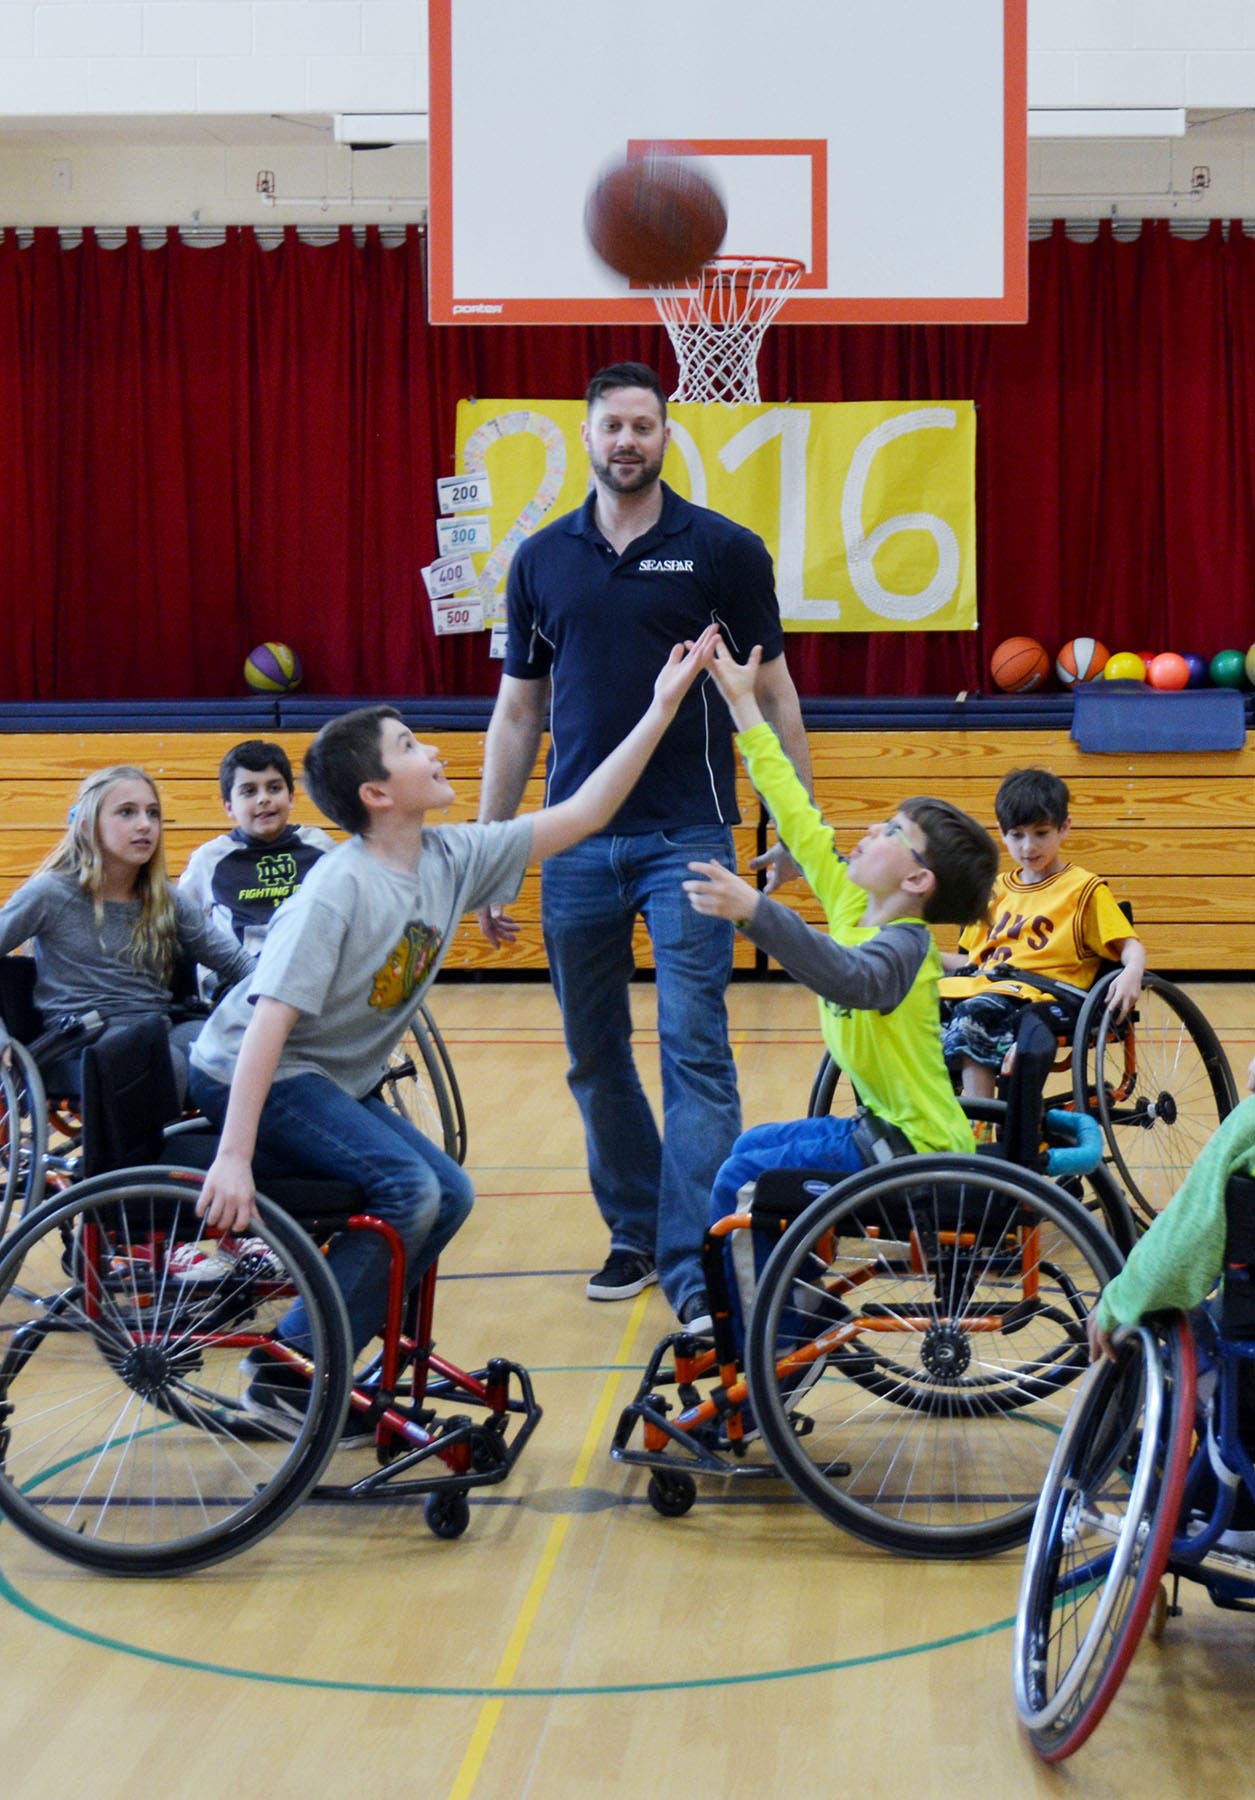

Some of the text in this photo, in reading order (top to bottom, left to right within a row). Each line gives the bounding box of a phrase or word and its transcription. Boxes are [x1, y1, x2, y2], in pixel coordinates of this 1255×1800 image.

[452, 485, 478, 502] 200
[451, 528, 476, 543] 300
[438, 564, 463, 583] 400
[638, 559, 694, 572] SEASPAR
[446, 609, 470, 625] 500
[238, 885, 290, 901] FIGHTING
